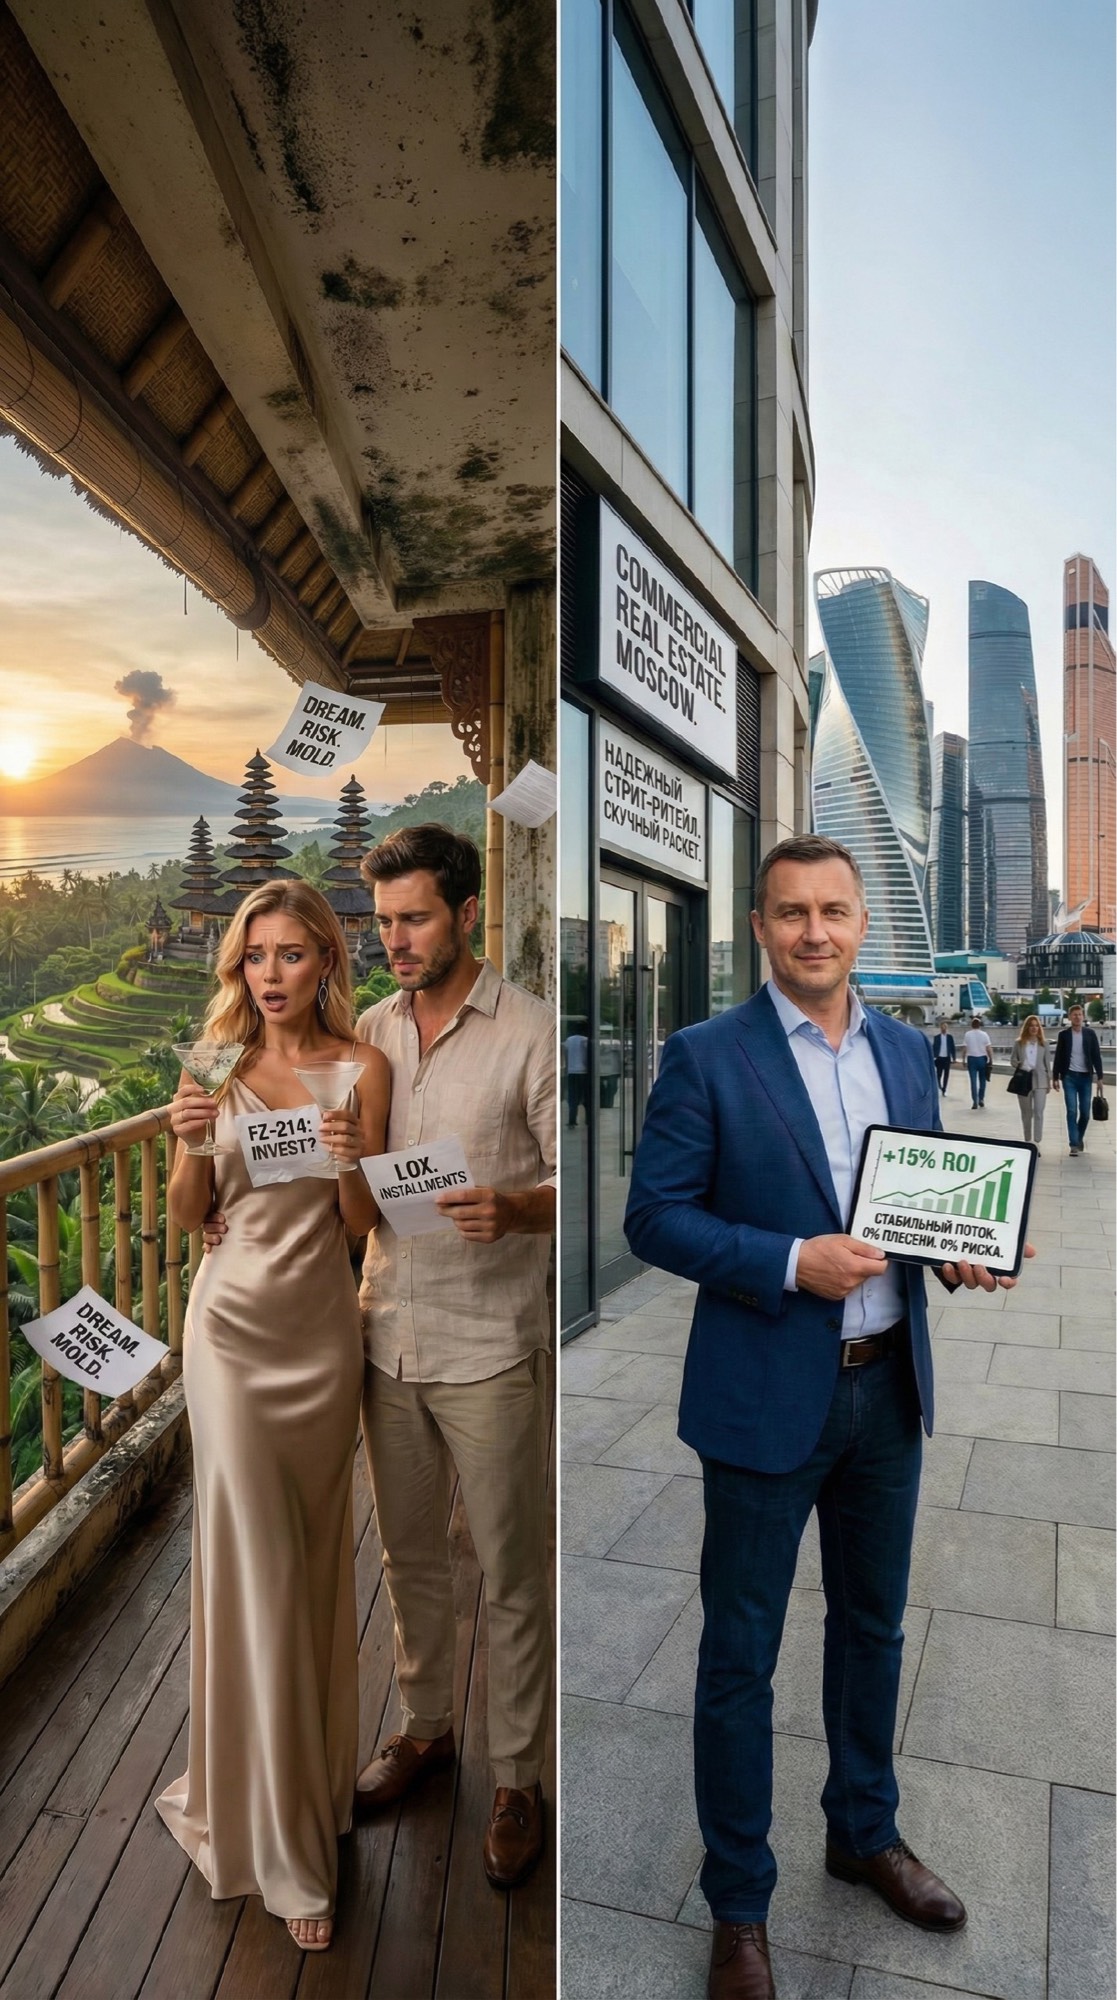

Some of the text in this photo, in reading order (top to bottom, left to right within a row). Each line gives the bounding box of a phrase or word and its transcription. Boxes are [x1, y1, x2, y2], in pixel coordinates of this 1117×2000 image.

[616, 543, 727, 677] COMMERCIAL
[616, 584, 727, 714] REAL ESTATE.
[616, 630, 698, 726] MOSCOW.
[302, 695, 367, 731] DREAM.
[299, 720, 342, 748] RISK.
[285, 739, 336, 768] MOLD.
[605, 739, 682, 803] НАДЕЖНЫЙ
[605, 770, 701, 839] СТРИТ-РИТЕЙЛ.
[604, 800, 702, 862] СКУЧНЫЙ РАСКЕТ.
[248, 1117, 313, 1142] FZ-214:
[251, 1137, 317, 1161] INVEST?
[883, 1146, 976, 1173] +15% ROI
[379, 1171, 468, 1200] INSTALLMENTS
[394, 1156, 439, 1182] LOX.
[862, 1226, 1004, 1258] 0% ПЛЕСЕНИ. 0% РИСКА.
[874, 1212, 997, 1240] СТАБИЛЬНЫЙ ПОТОК.
[68, 1323, 114, 1363] RISK.
[76, 1302, 140, 1358] DREAM.
[50, 1332, 102, 1380] MOLD.
